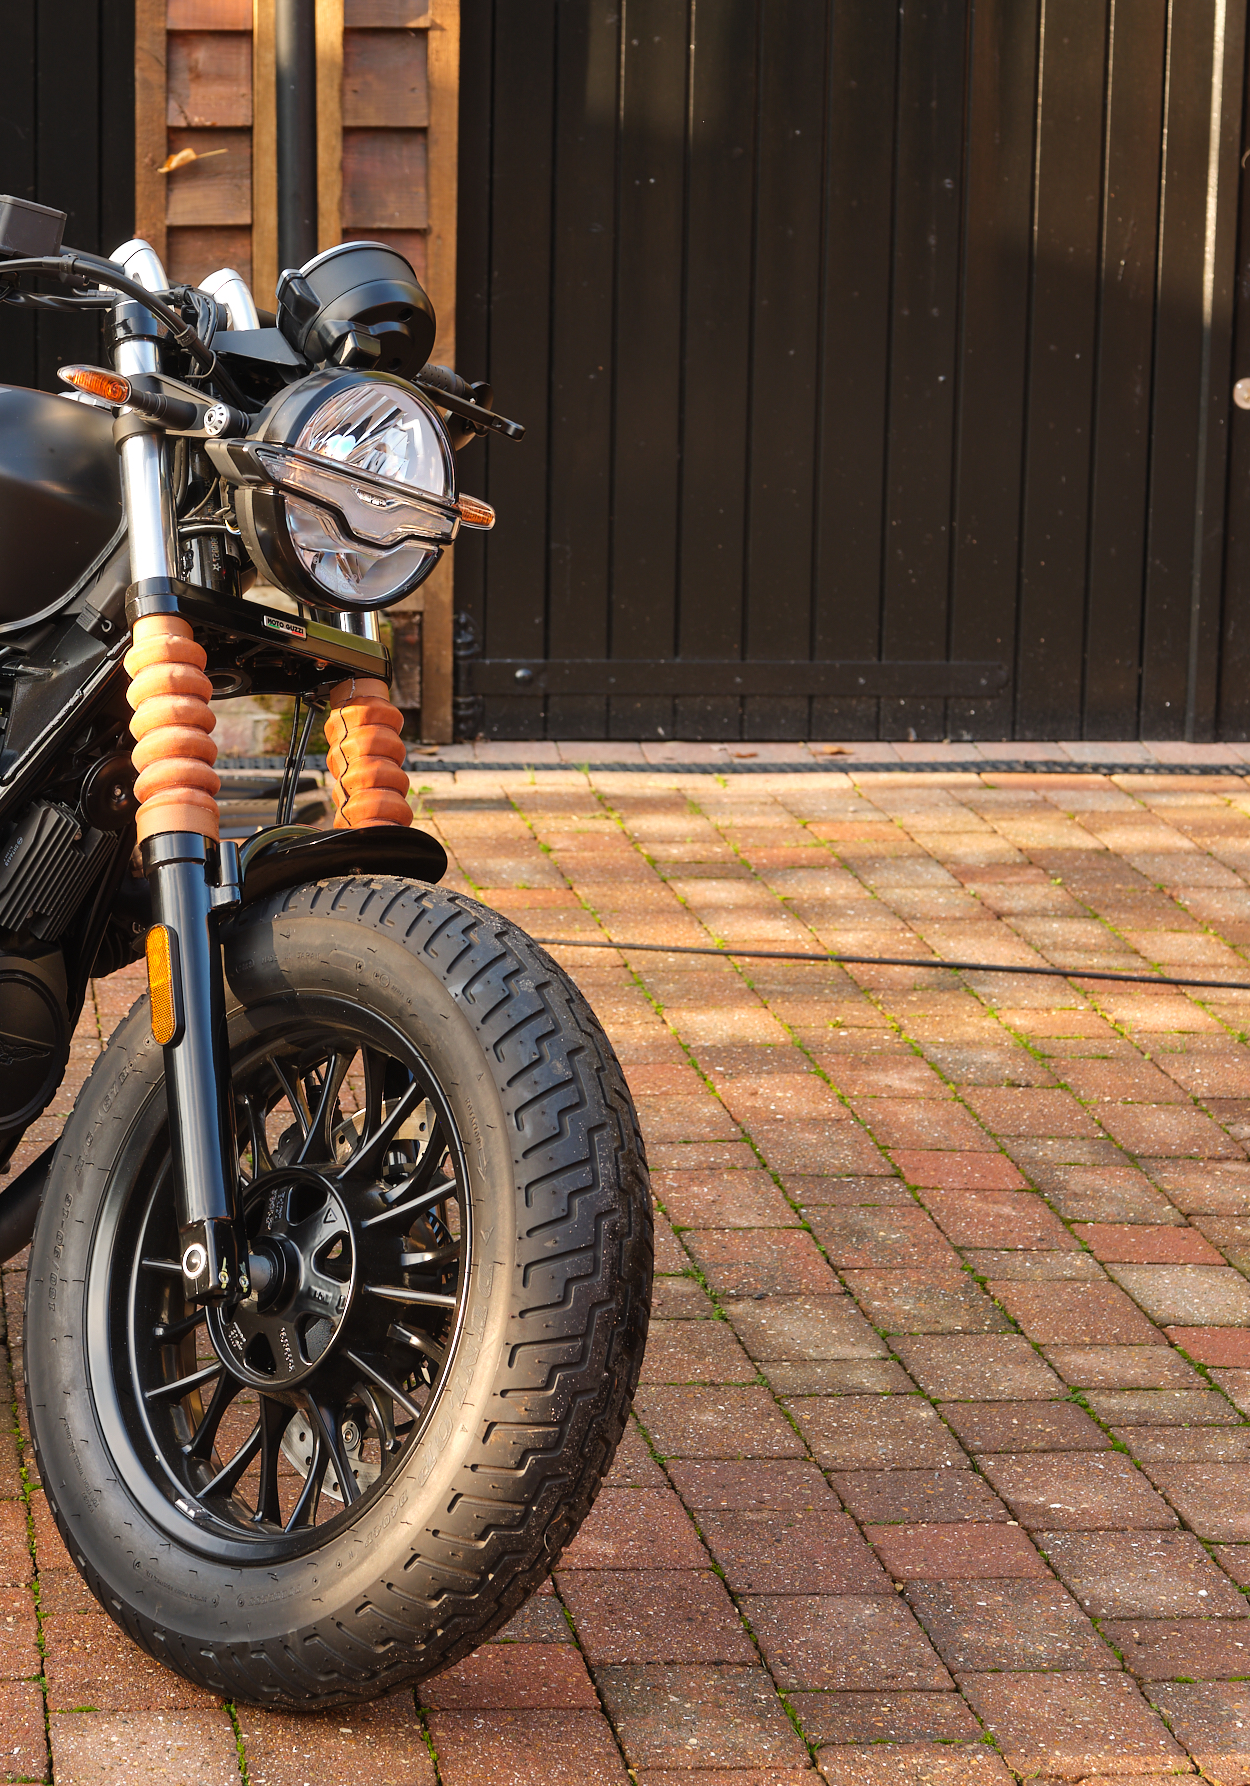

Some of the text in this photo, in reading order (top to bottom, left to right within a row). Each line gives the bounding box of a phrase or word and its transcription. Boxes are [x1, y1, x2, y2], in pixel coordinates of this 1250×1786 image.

[267, 617, 304, 634] MOTO GUZZI
[413, 1259, 495, 1488] DUNLOP
